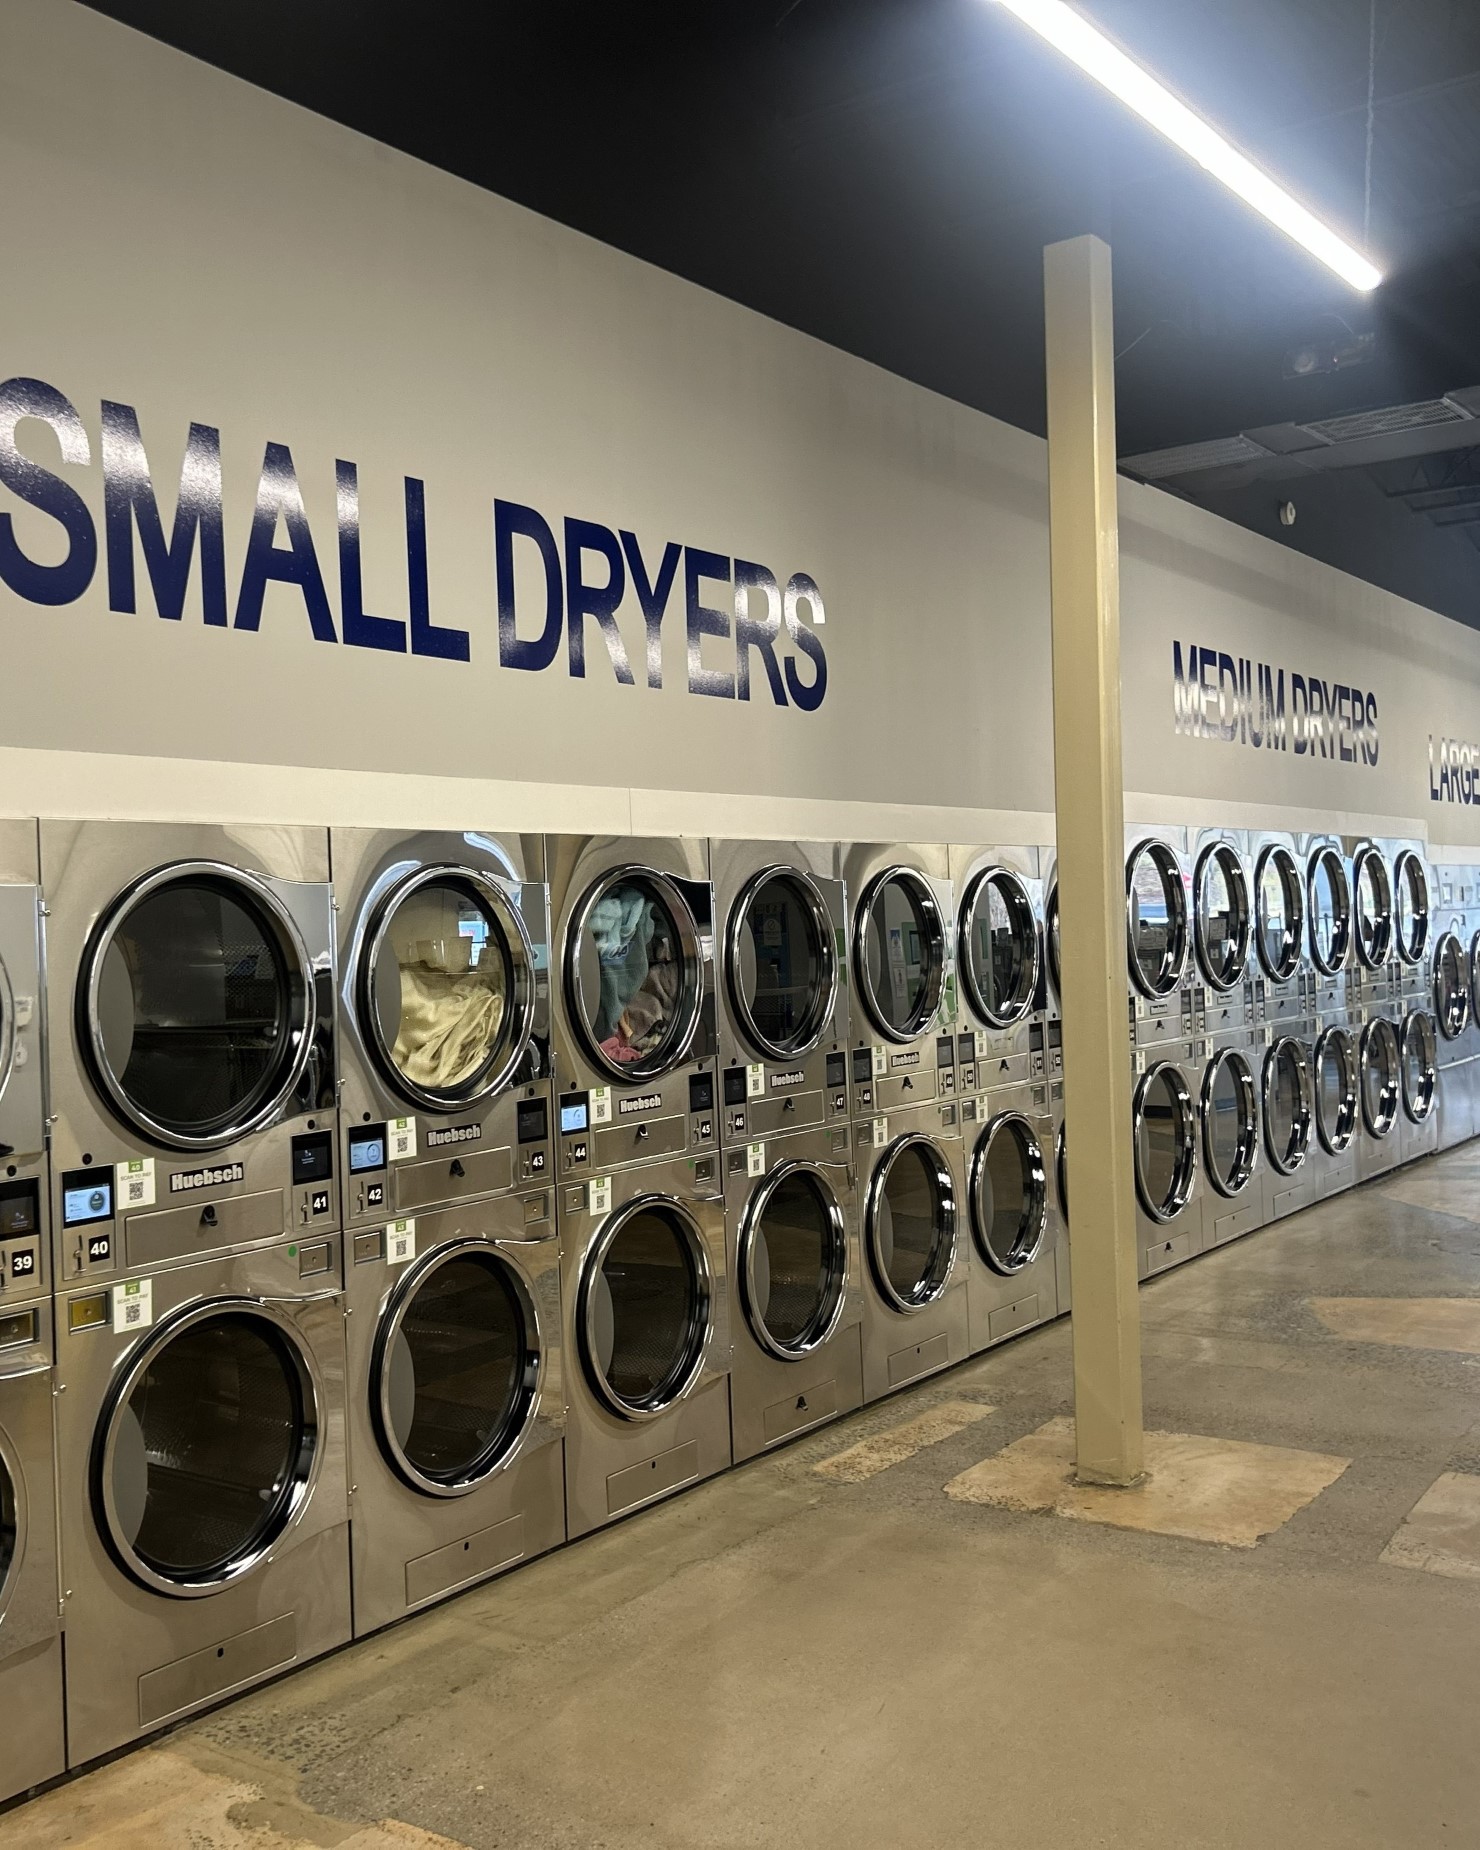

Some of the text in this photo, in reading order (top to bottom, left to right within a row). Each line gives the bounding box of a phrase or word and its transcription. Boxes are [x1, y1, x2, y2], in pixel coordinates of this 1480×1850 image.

[0, 377, 828, 712] SMALL DRYERS
[1173, 640, 1379, 767] MEDIUM DRYERS
[1428, 734, 1480, 805] LARGE
[772, 1072, 804, 1087] Huebsch
[620, 1094, 661, 1113] Huebsch
[836, 1097, 844, 1106] 47
[702, 1124, 710, 1134] 45
[736, 1118, 744, 1126] 46
[428, 1124, 480, 1146] Huebsch
[575, 1147, 586, 1158] 44
[532, 1156, 544, 1166] 43
[172, 1164, 242, 1190] Huebsch
[368, 1188, 382, 1200] 42
[314, 1196, 326, 1208] 41
[90, 1240, 108, 1256] 40
[14, 1256, 32, 1271] 39
